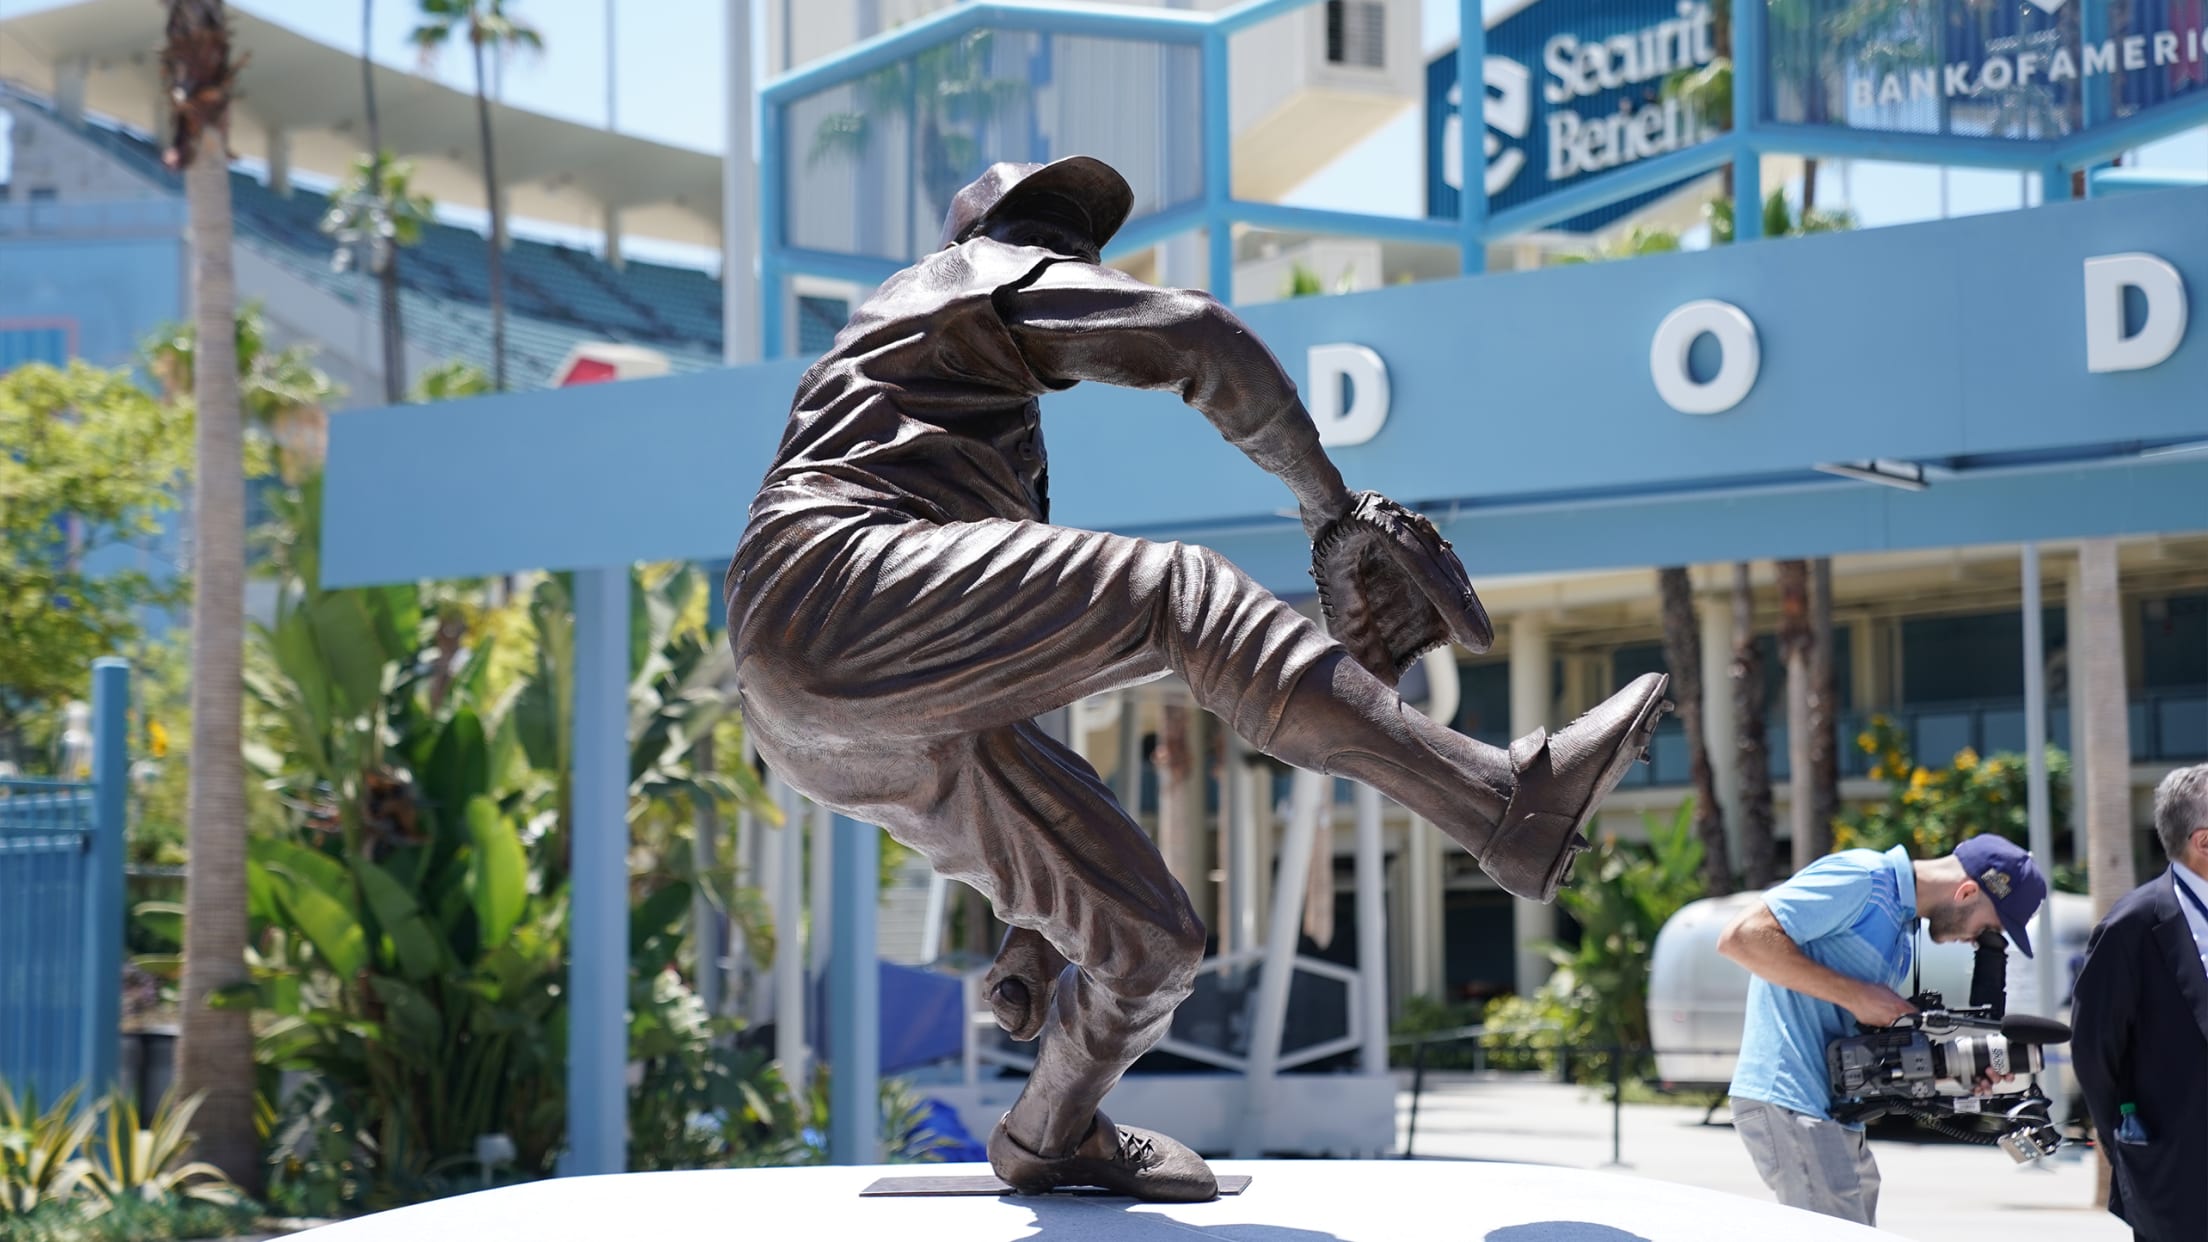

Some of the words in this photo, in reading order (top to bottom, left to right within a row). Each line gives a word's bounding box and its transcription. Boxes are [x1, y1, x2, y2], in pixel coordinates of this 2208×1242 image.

[1544, 0, 1718, 103] Securit
[1851, 60, 1971, 109] BANK
[1981, 53, 2038, 91] OF
[2049, 26, 2208, 82] AMERI
